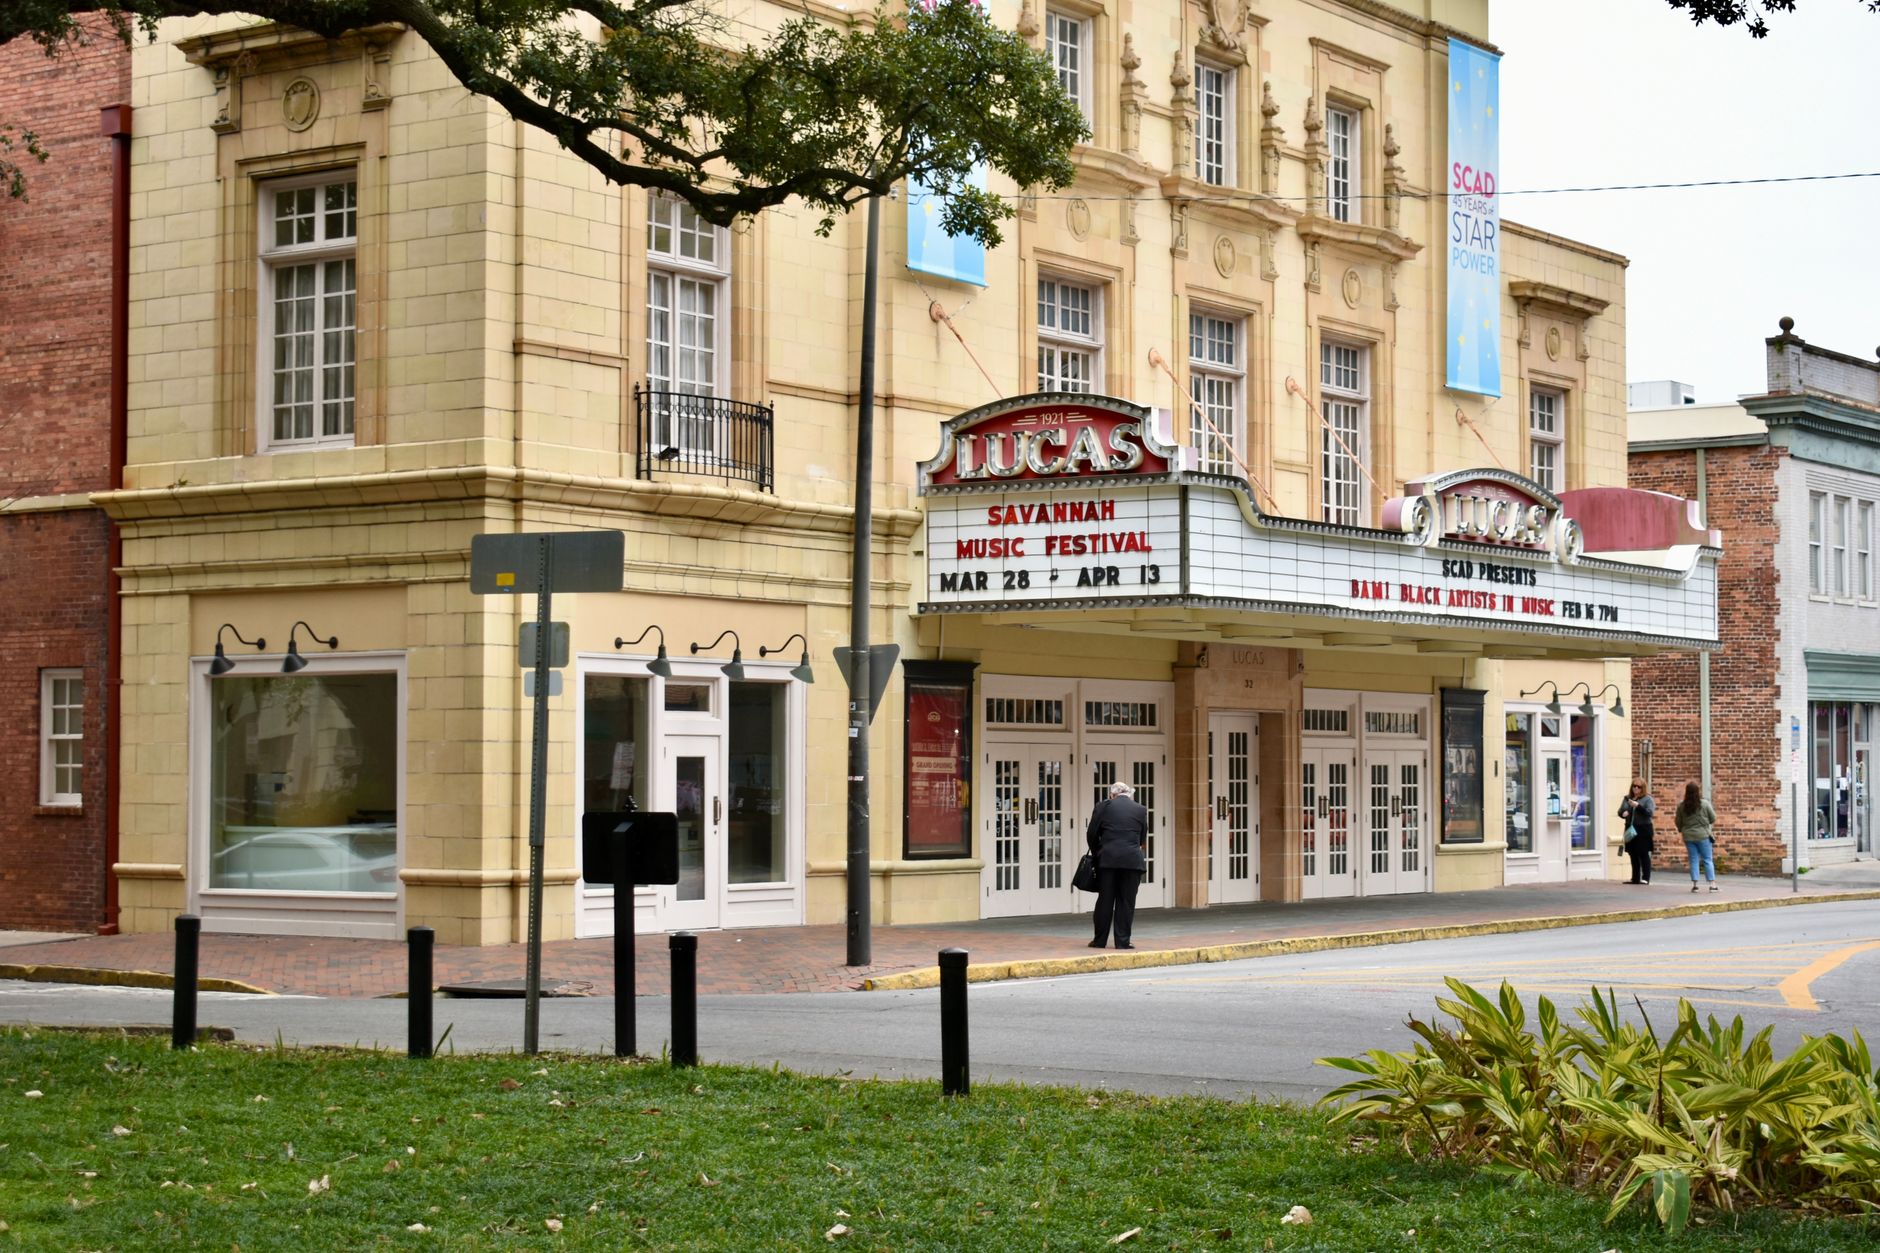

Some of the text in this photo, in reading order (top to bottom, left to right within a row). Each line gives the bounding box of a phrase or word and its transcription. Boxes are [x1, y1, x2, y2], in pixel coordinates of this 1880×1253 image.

[1453, 162, 1495, 199] SCAD
[1463, 196, 1488, 216] YEARS
[1452, 211, 1495, 252] STAR
[1452, 246, 1495, 276] POWER
[1040, 413, 1064, 425] 1921
[954, 422, 1144, 479] LUCAS
[987, 500, 1115, 526] SAVANNAH
[1445, 493, 1547, 545] LUCAS
[956, 531, 1153, 559] MUSIC FESTIVAL
[940, 564, 1161, 592] MAR 28 APR 13
[1442, 559, 1537, 586] SCAD PRESENTS
[1351, 579, 1618, 622] BAM! BLACK ARTISTS IN MUSIC FEB 16 7PM
[1232, 650, 1265, 665] LUCAS
[1244, 679, 1254, 689] 32
